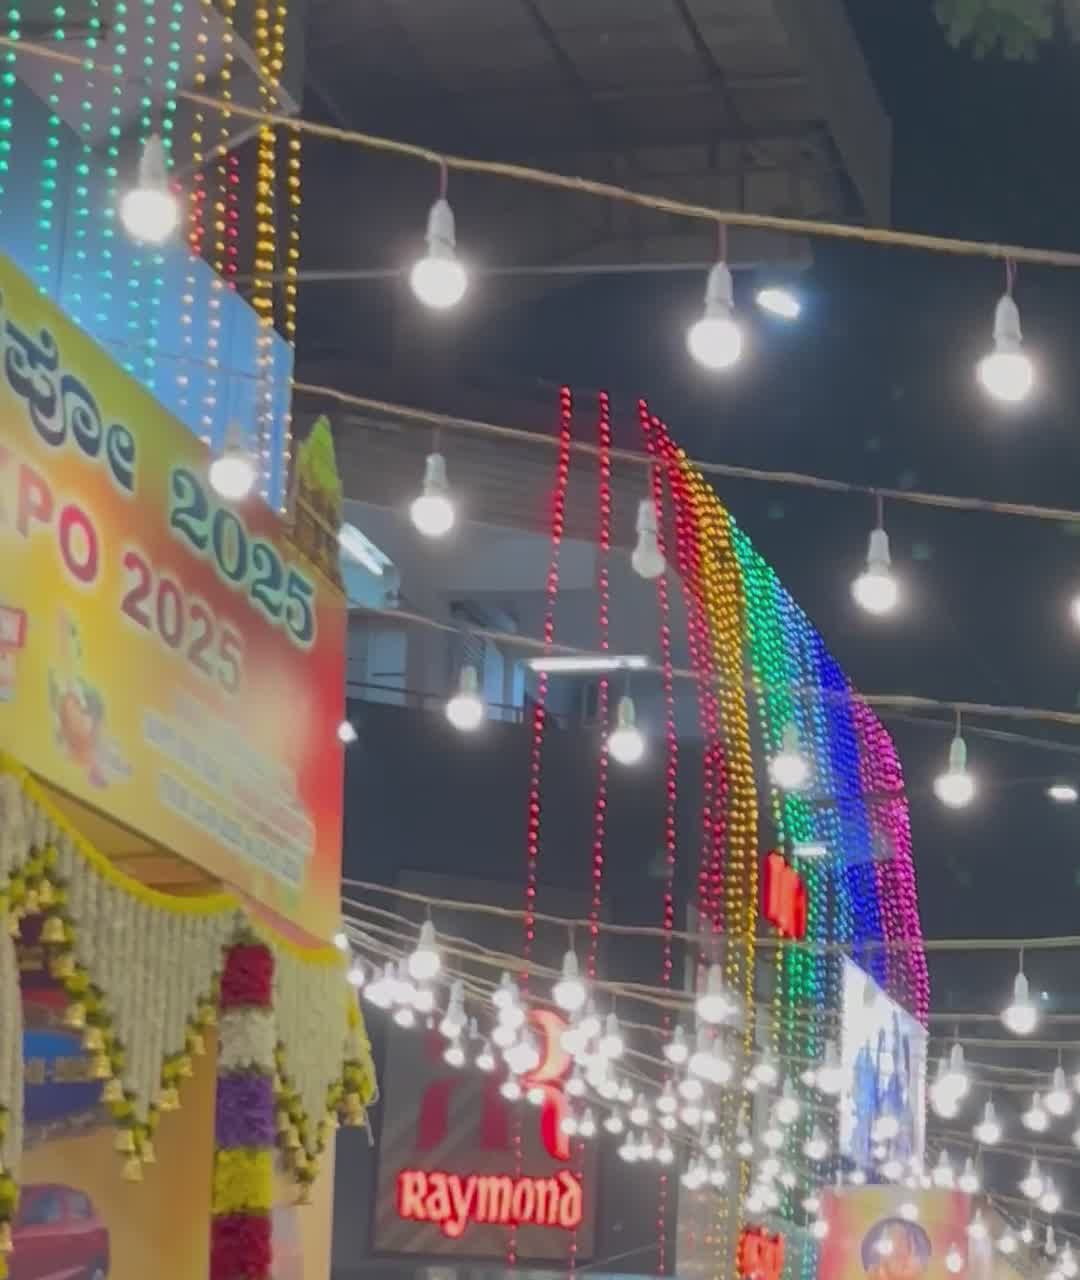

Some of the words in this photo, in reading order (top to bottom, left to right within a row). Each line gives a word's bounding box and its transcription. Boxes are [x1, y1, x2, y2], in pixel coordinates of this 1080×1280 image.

[12, 462, 99, 584] PO
[121, 551, 242, 694] 2025
[171, 468, 313, 643] 2025
[395, 1169, 584, 1237] Raymond
